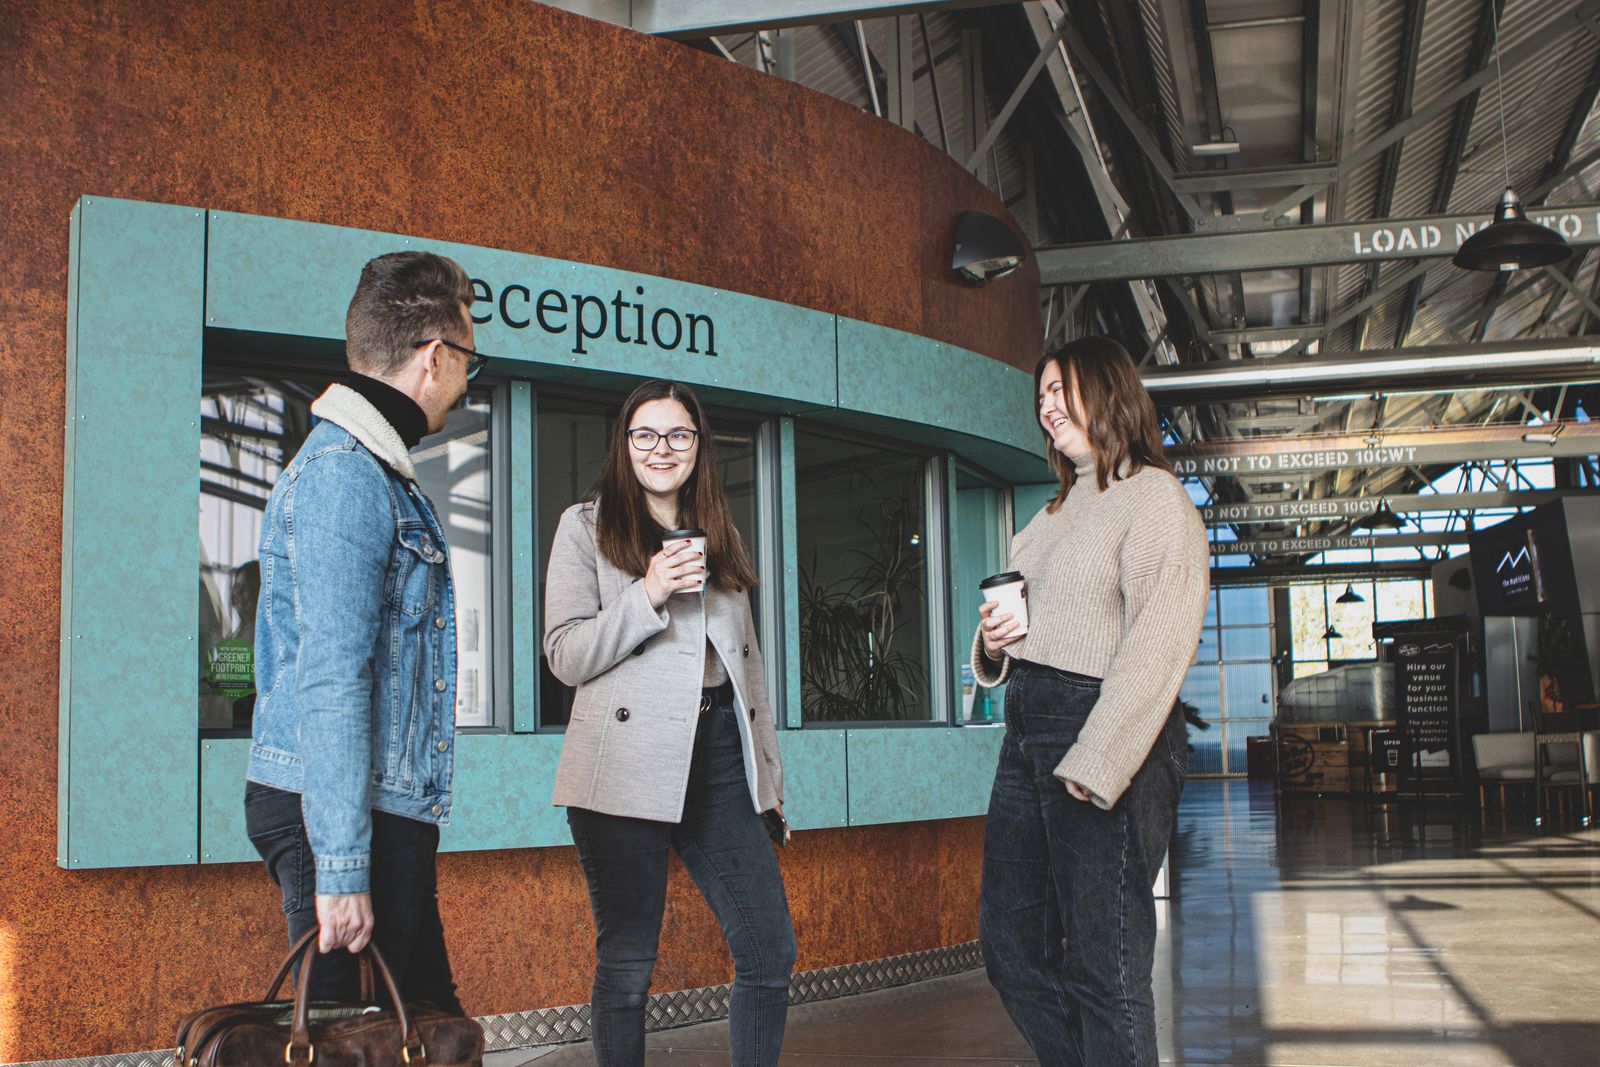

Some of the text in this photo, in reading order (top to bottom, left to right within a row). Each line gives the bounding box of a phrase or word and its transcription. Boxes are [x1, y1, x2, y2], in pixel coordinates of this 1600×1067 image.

[1353, 225, 1442, 255] LOAD
[468, 277, 718, 357] eception
[1174, 447, 1417, 473] AD NOT TO EXCEED 10CWT
[1220, 507, 1250, 519] NOT
[1255, 505, 1275, 516] TO
[1280, 502, 1338, 516] EXCEED
[1343, 499, 1393, 514] 10C
[1230, 542, 1256, 552] NOT
[1261, 541, 1278, 551] TO
[1282, 538, 1331, 550] EXCEED
[1337, 537, 1378, 548] 10CWT
[218, 652, 251, 662] GREENER
[211, 663, 255, 673] FOOTPRINTS
[1407, 663, 1427, 671] Hire
[1425, 685, 1447, 693] your
[1407, 694, 1448, 702] business
[1407, 705, 1448, 713] function
